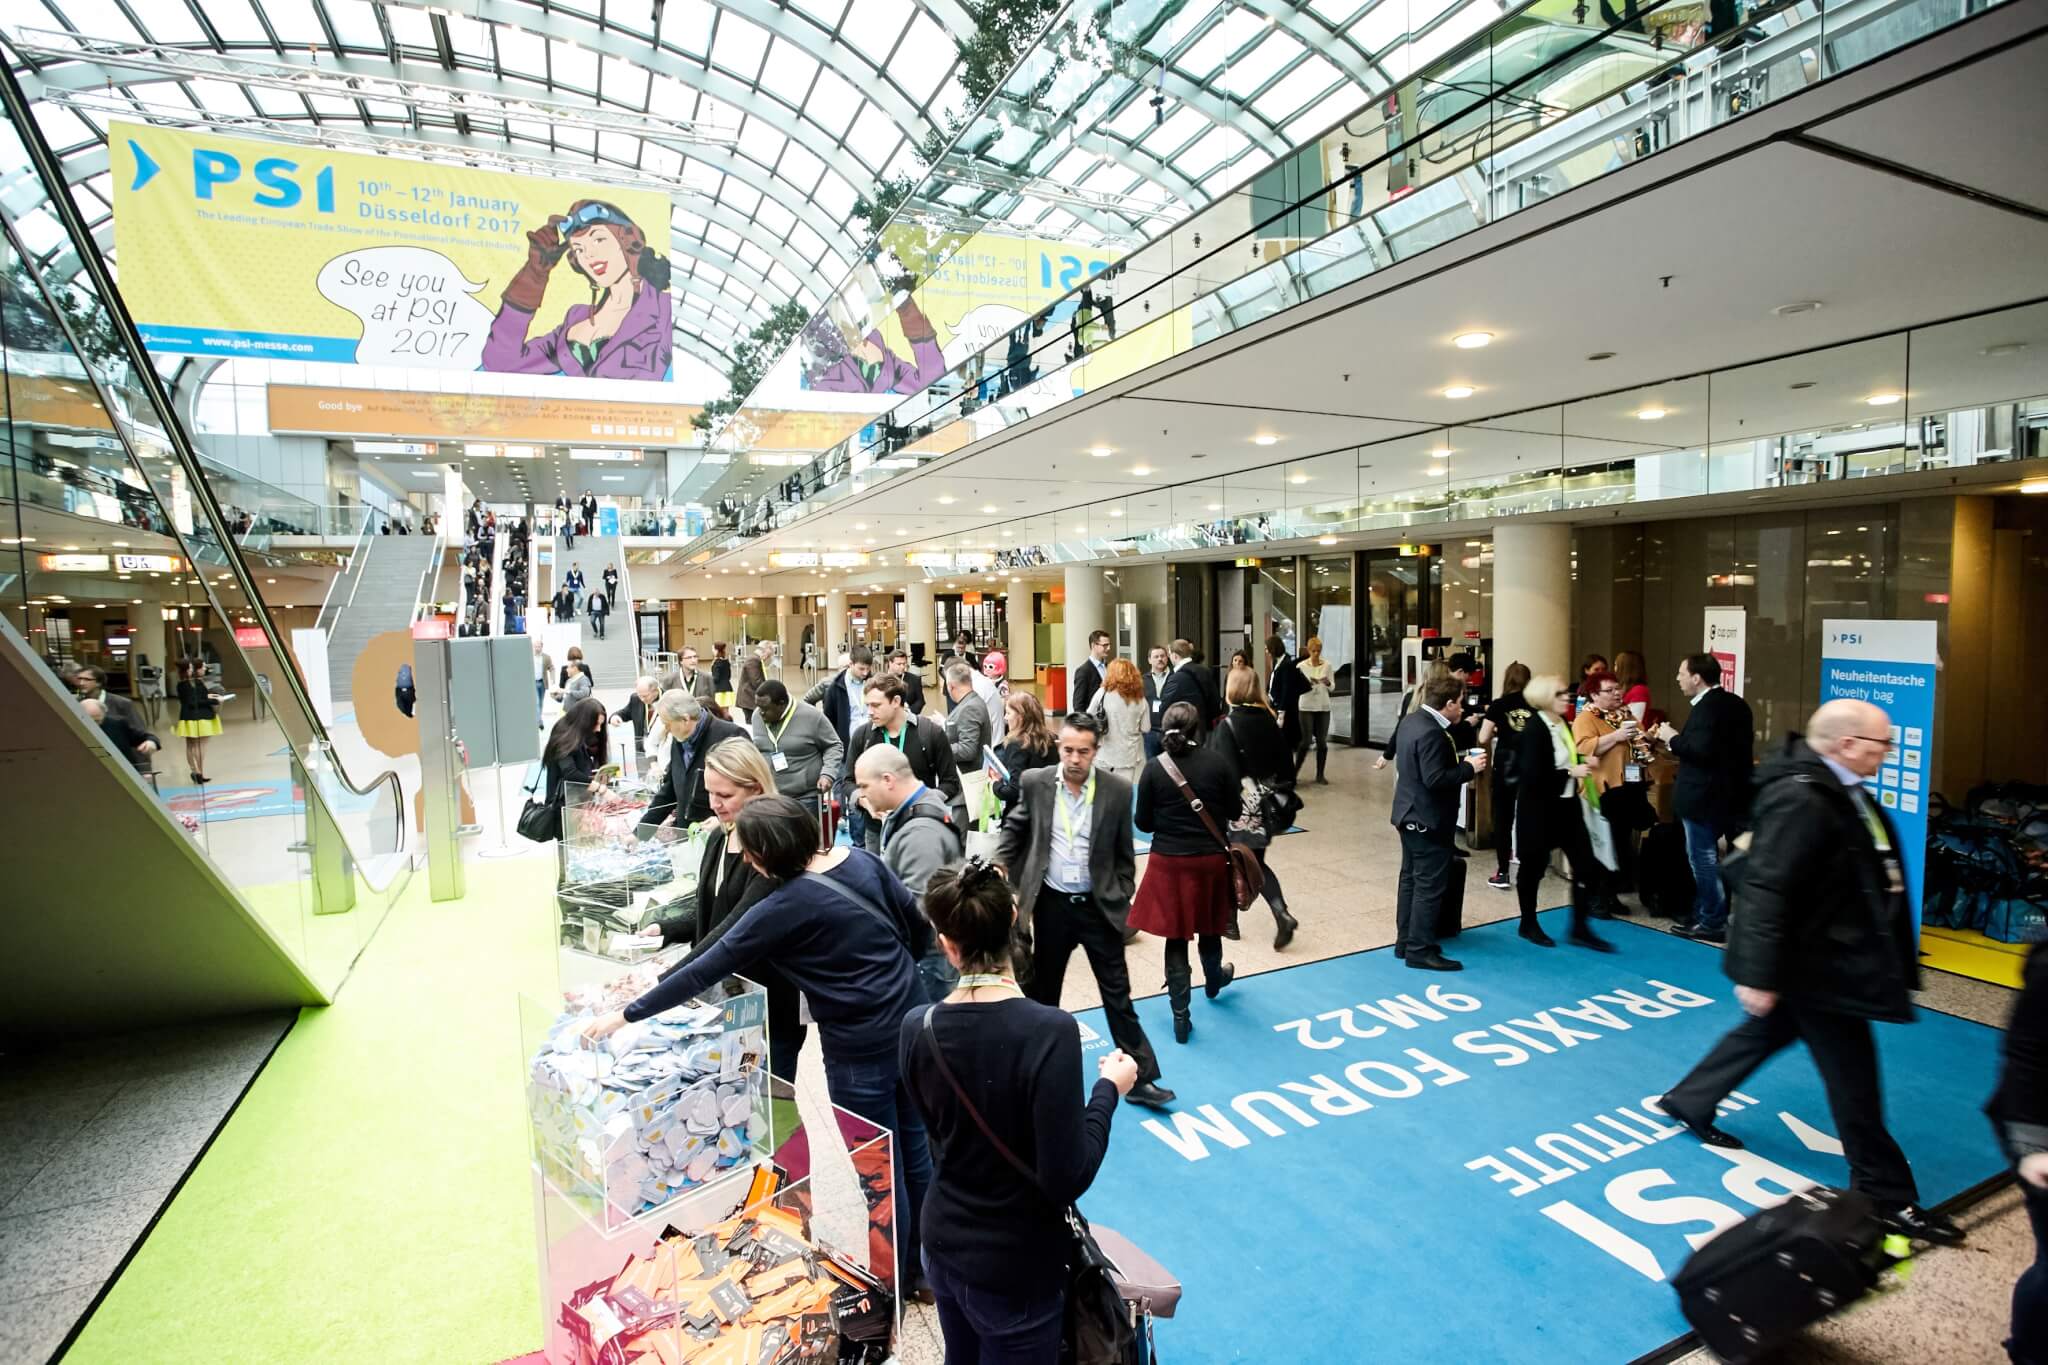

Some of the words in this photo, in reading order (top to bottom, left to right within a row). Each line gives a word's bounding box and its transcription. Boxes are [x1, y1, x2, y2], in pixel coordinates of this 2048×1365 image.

[192, 148, 336, 213] PSI
[358, 181, 391, 197] 10th
[411, 187, 444, 202] 12th
[450, 191, 520, 216] January
[359, 202, 470, 229] Düsseldorf
[477, 216, 521, 234] 2017
[340, 259, 389, 288] See
[397, 273, 446, 298] you
[371, 300, 397, 321] at
[407, 298, 457, 326] PSI
[202, 336, 314, 353] www.psi-messe.com
[391, 329, 470, 358] 2017
[318, 400, 343, 411] Good
[345, 401, 363, 413] bye
[1840, 633, 1862, 644] PSI
[1831, 668, 1926, 687] Neuheitentasche
[1830, 685, 1870, 701] Novelty
[1873, 689, 1895, 705] bag
[1272, 984, 1483, 1050] 9M22
[1451, 979, 1716, 1067] PRAXIS
[1139, 1047, 1471, 1162] FORUM
[1463, 1090, 1760, 1198] ITITUTE
[1539, 1143, 1833, 1282] PSI
